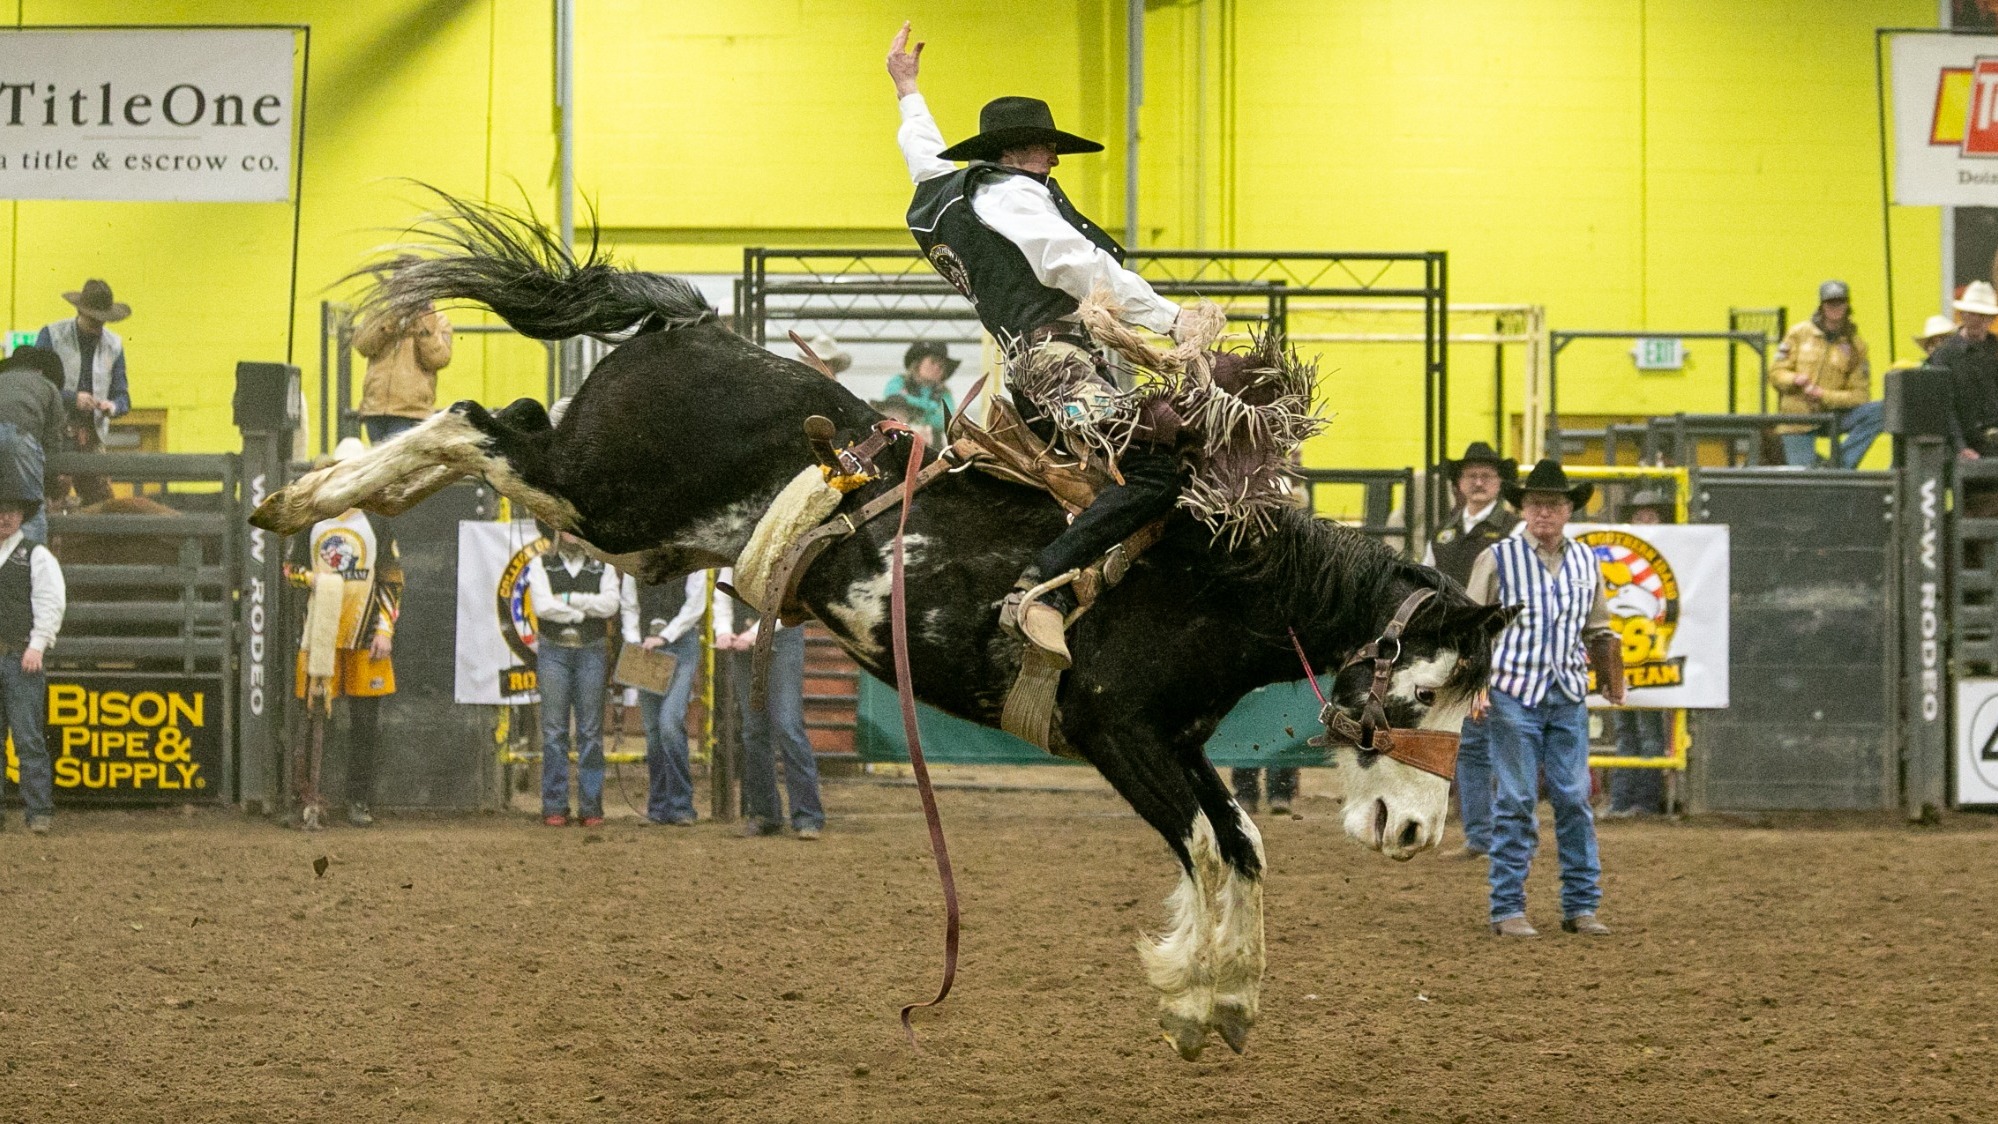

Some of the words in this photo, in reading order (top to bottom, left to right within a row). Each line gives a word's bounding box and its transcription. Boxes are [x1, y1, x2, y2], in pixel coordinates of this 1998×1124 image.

[0, 82, 281, 127] TitleOne
[22, 150, 78, 170] title
[92, 151, 111, 170] &
[124, 152, 228, 171] escrow
[241, 154, 279, 171] co.
[251, 577, 265, 717] RODEO
[1920, 582, 1938, 722] RODEO
[47, 684, 205, 727] BISON
[61, 727, 150, 758] PIPE
[153, 726, 192, 763] &
